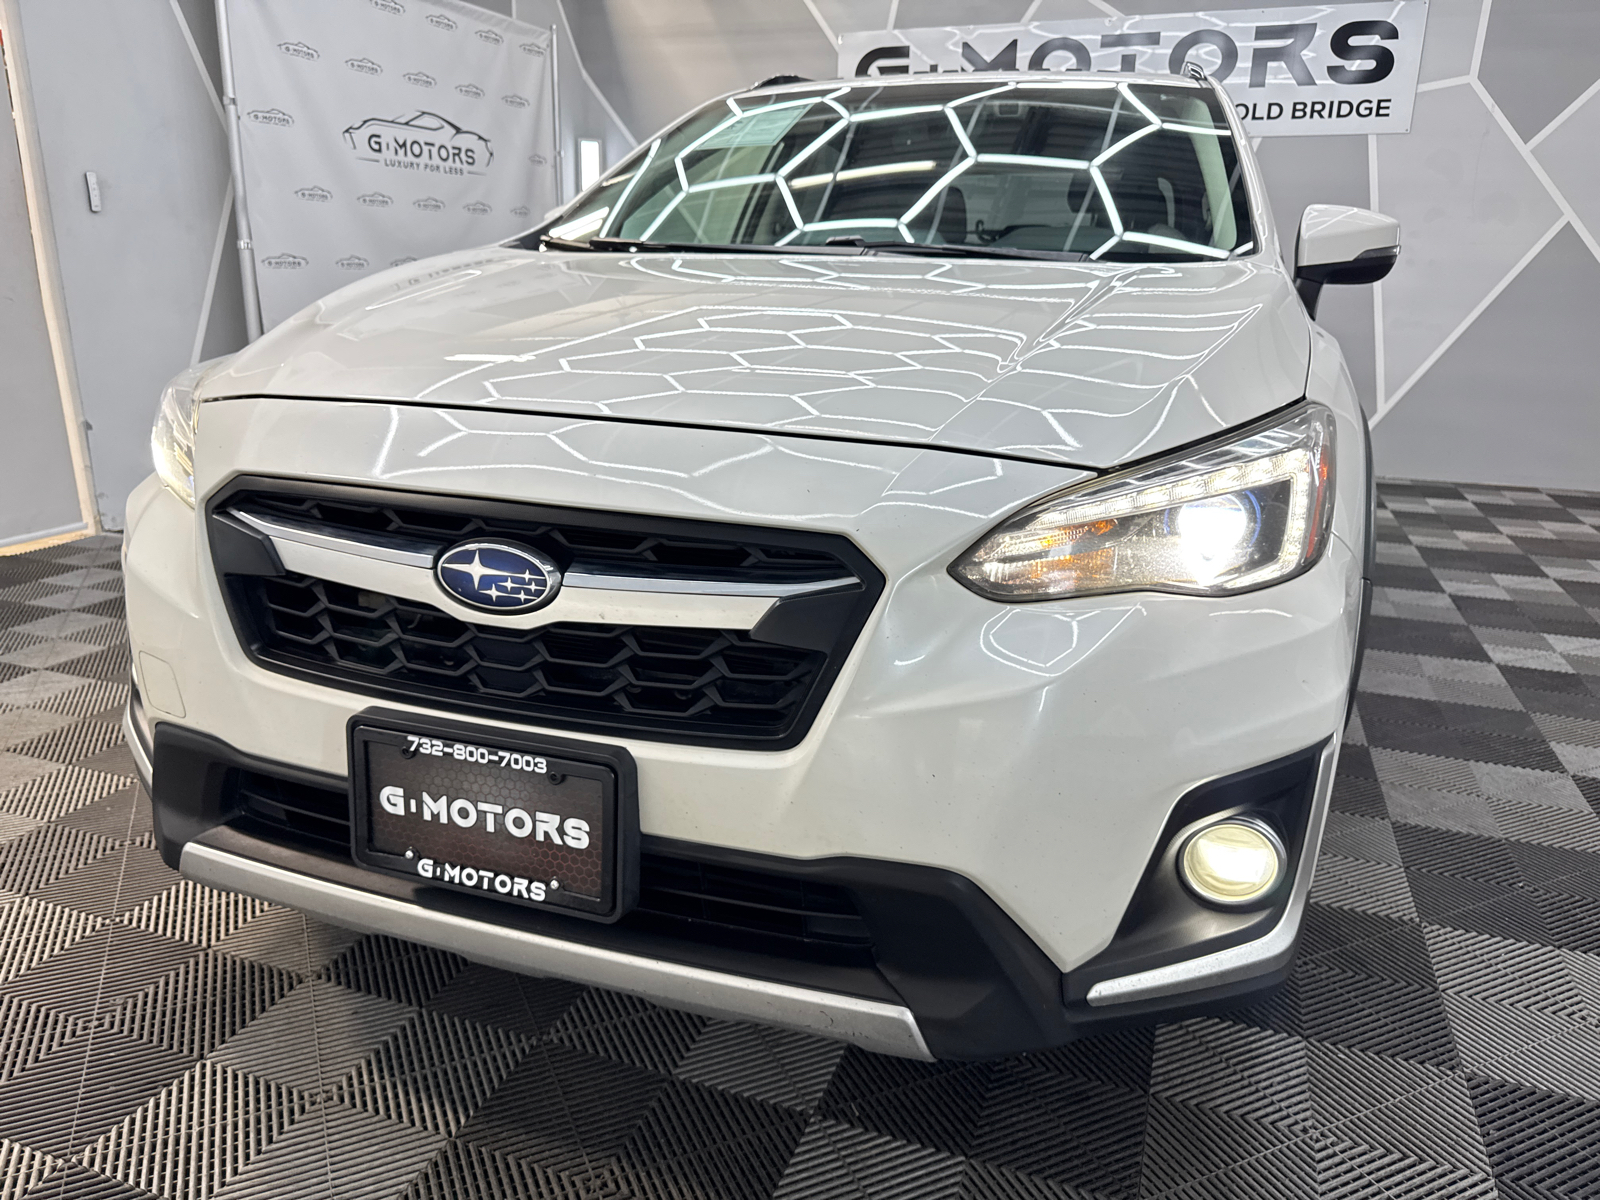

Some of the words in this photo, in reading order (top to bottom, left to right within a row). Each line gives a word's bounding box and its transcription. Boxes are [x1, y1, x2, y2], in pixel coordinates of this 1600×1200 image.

[1291, 98, 1392, 119] BRIDGE
[384, 159, 420, 170] LUXURY
[424, 164, 441, 172] FOR
[443, 166, 464, 175] LESS
[407, 736, 547, 774] 732-800-7003
